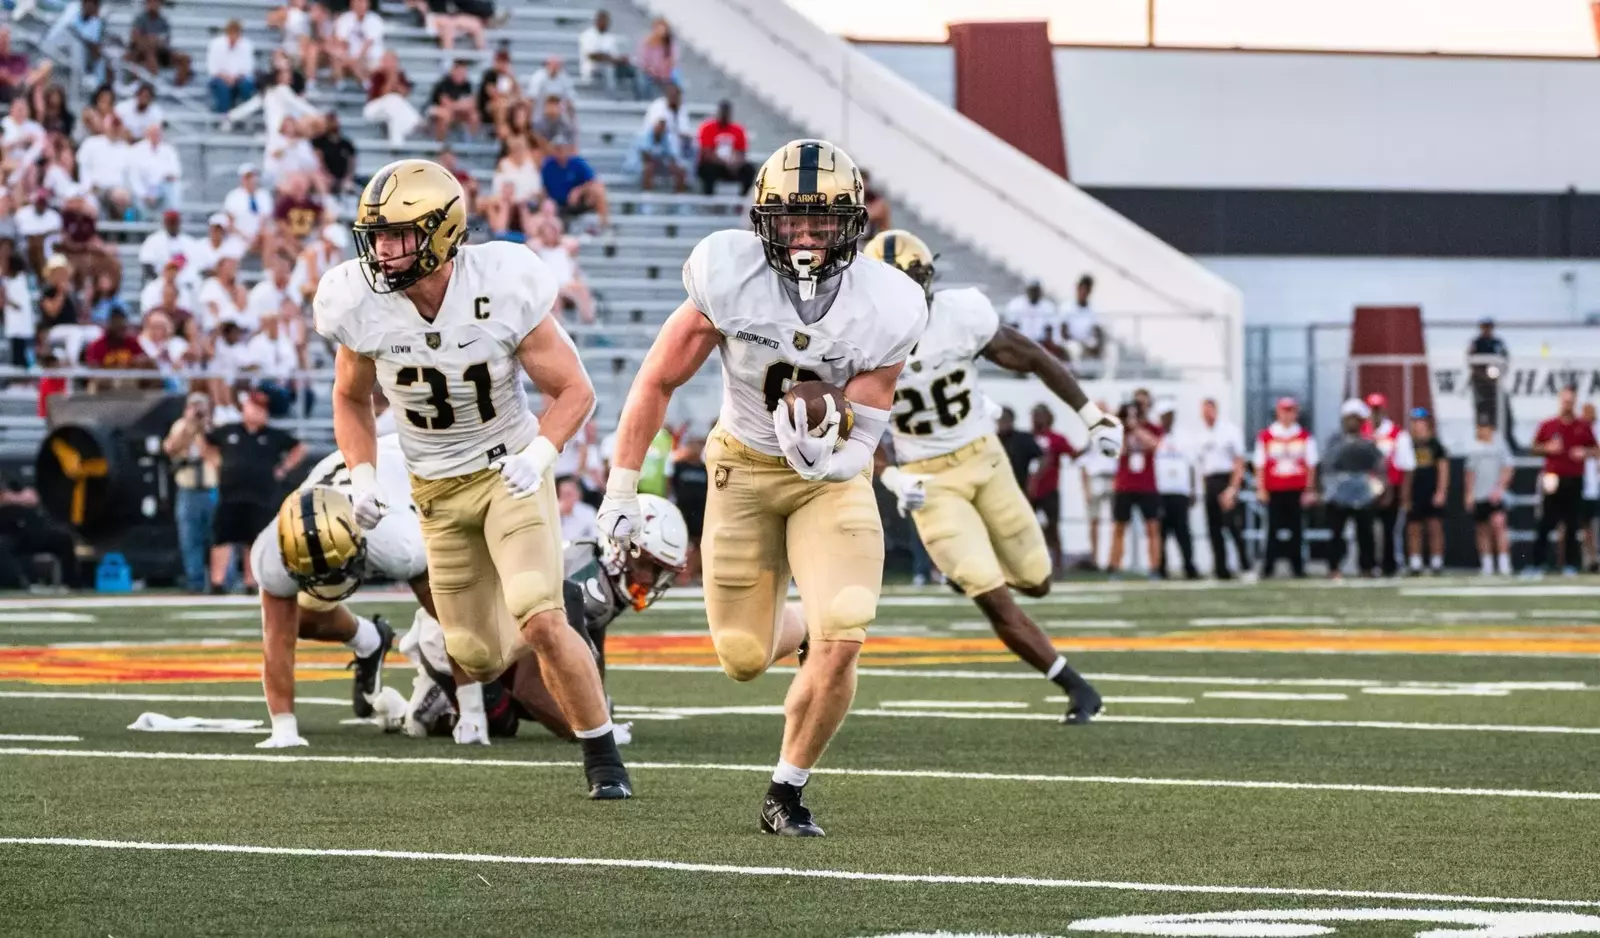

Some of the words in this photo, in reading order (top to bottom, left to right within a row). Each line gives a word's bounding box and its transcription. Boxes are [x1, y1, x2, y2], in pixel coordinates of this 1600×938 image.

[797, 194, 819, 204] ARMY
[474, 296, 490, 320] C
[390, 345, 412, 354] LOWIN
[736, 330, 780, 350] DIDOMENICO
[1435, 368, 1600, 396] WHAW
[395, 361, 497, 430] 31
[892, 368, 971, 435] 26
